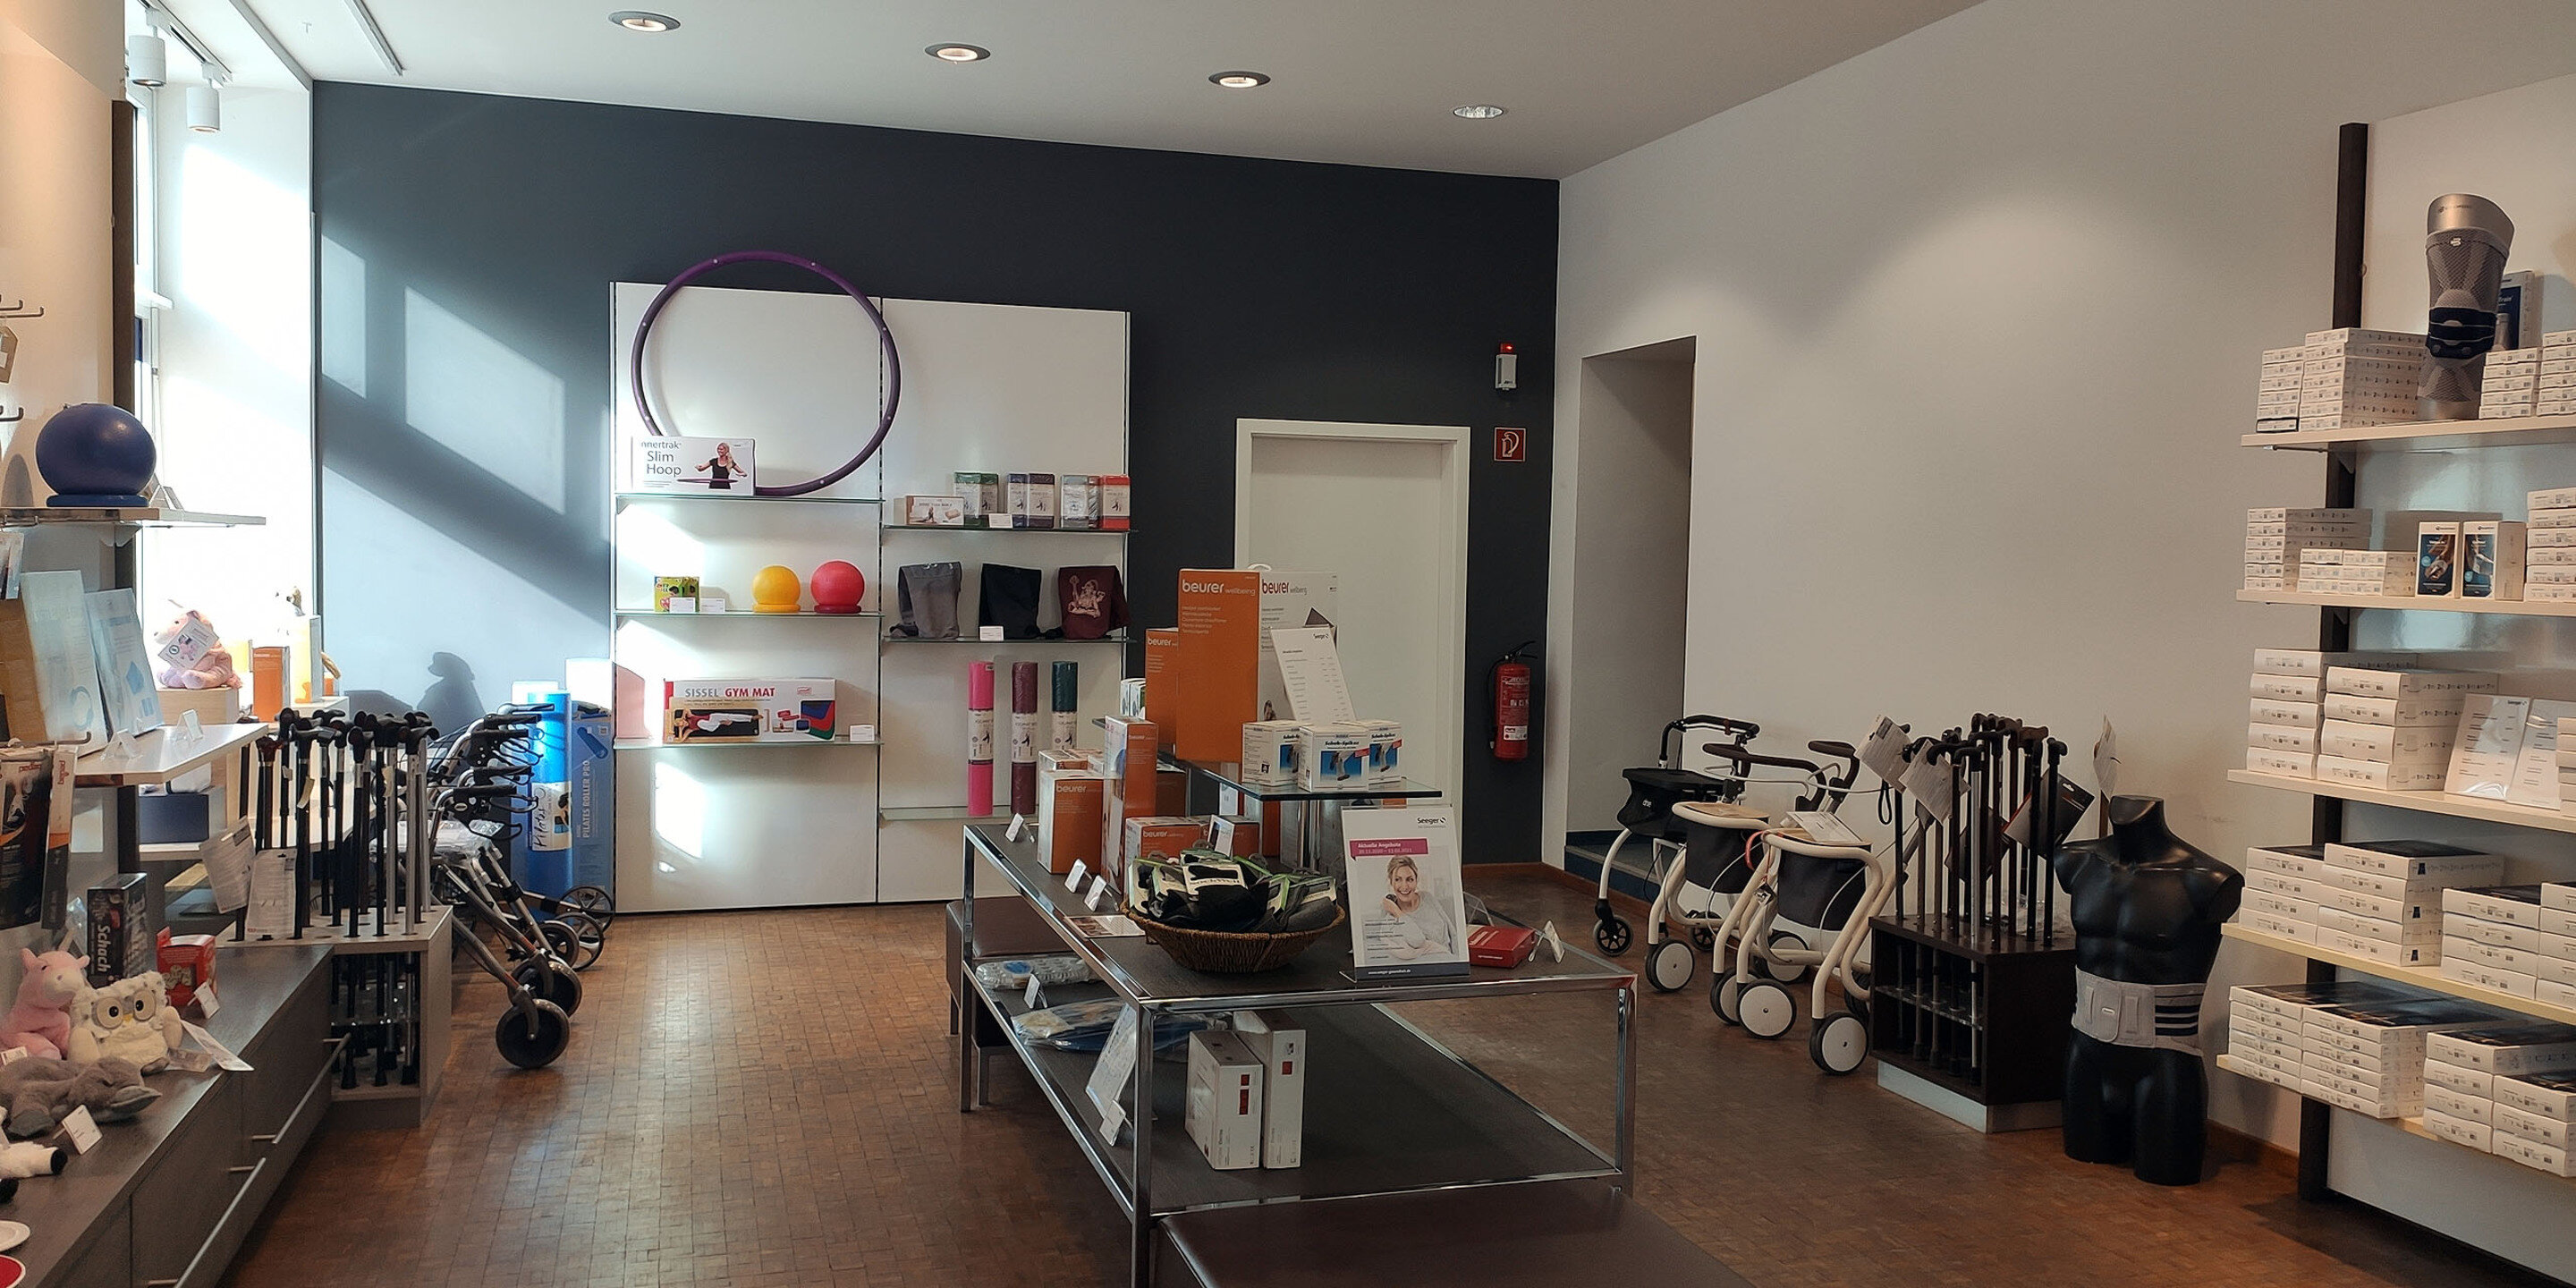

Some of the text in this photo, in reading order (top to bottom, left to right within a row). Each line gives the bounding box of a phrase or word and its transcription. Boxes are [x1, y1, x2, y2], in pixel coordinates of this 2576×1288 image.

[647, 451, 674, 462] Slim
[647, 463, 682, 477] Hoop
[1182, 580, 1224, 594] beurer
[1261, 579, 1289, 594] beurer
[1148, 638, 1172, 646] beurer
[684, 688, 775, 698] SISSEL GYM MAT
[1056, 784, 1087, 793] beurer
[582, 760, 590, 838] PILATES ROLLER PRO
[1417, 817, 1439, 825] Seeger
[97, 925, 112, 972] Schach
